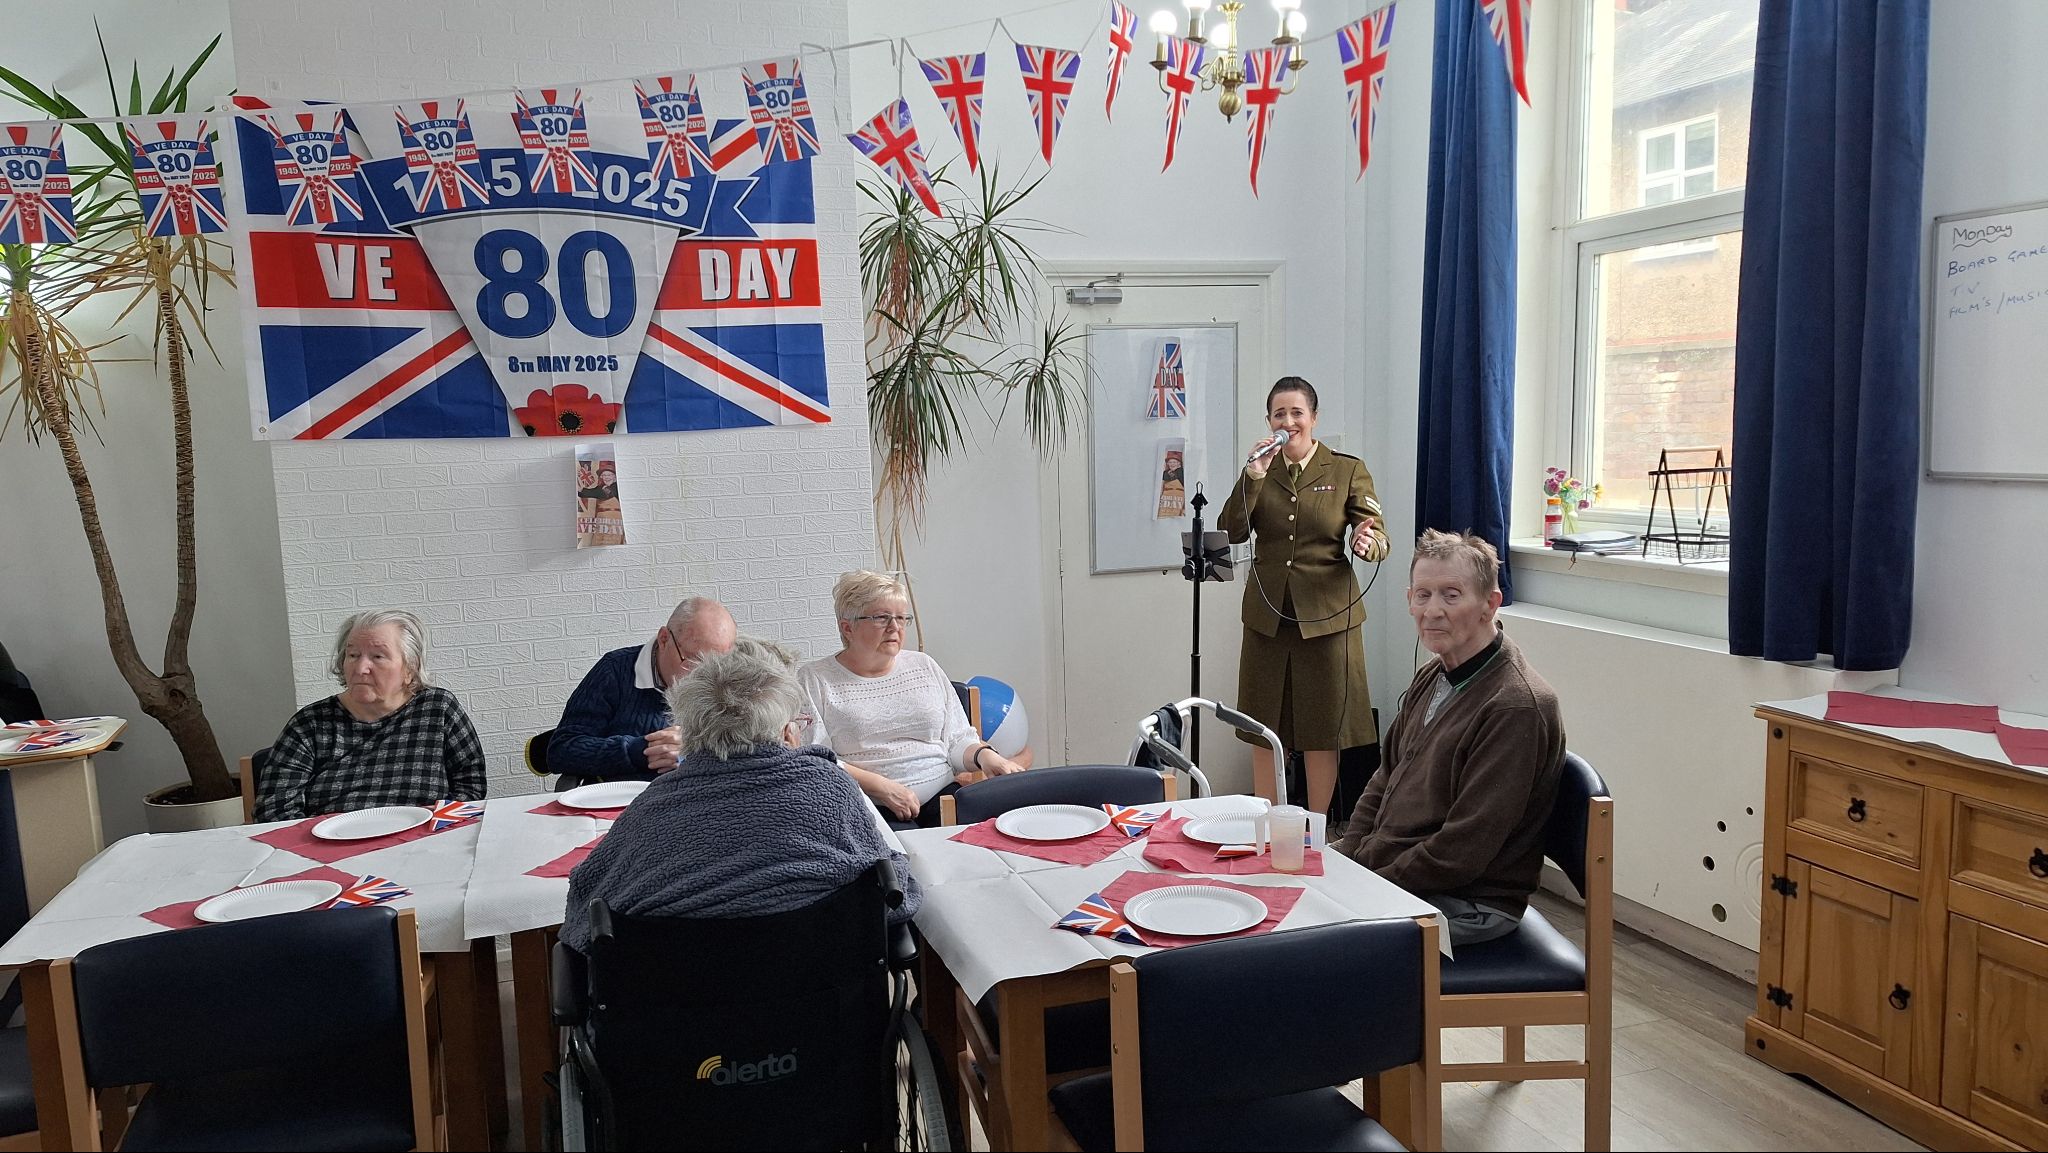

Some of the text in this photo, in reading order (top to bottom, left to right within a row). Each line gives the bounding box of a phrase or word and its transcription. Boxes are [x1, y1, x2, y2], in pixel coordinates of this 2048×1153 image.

[765, 89, 790, 108] 80
[659, 104, 686, 122] 80
[540, 117, 568, 136] 80
[171, 141, 191, 149] DAY
[423, 131, 453, 151] 80
[21, 147, 42, 155] DAY
[296, 144, 328, 164] 80
[456, 147, 476, 156] 2025
[5, 160, 43, 180] 80
[157, 153, 191, 173] 80
[278, 167, 299, 175] 1945
[330, 162, 351, 171] 2025
[44, 181, 69, 190] 2025
[138, 175, 160, 184] 1945
[194, 172, 216, 180] 2025
[314, 242, 398, 301] VE
[698, 247, 797, 302] DAY
[473, 229, 637, 338] 80
[536, 356, 571, 373] MAY
[574, 355, 619, 372] 2025
[711, 1053, 797, 1086] alerta
